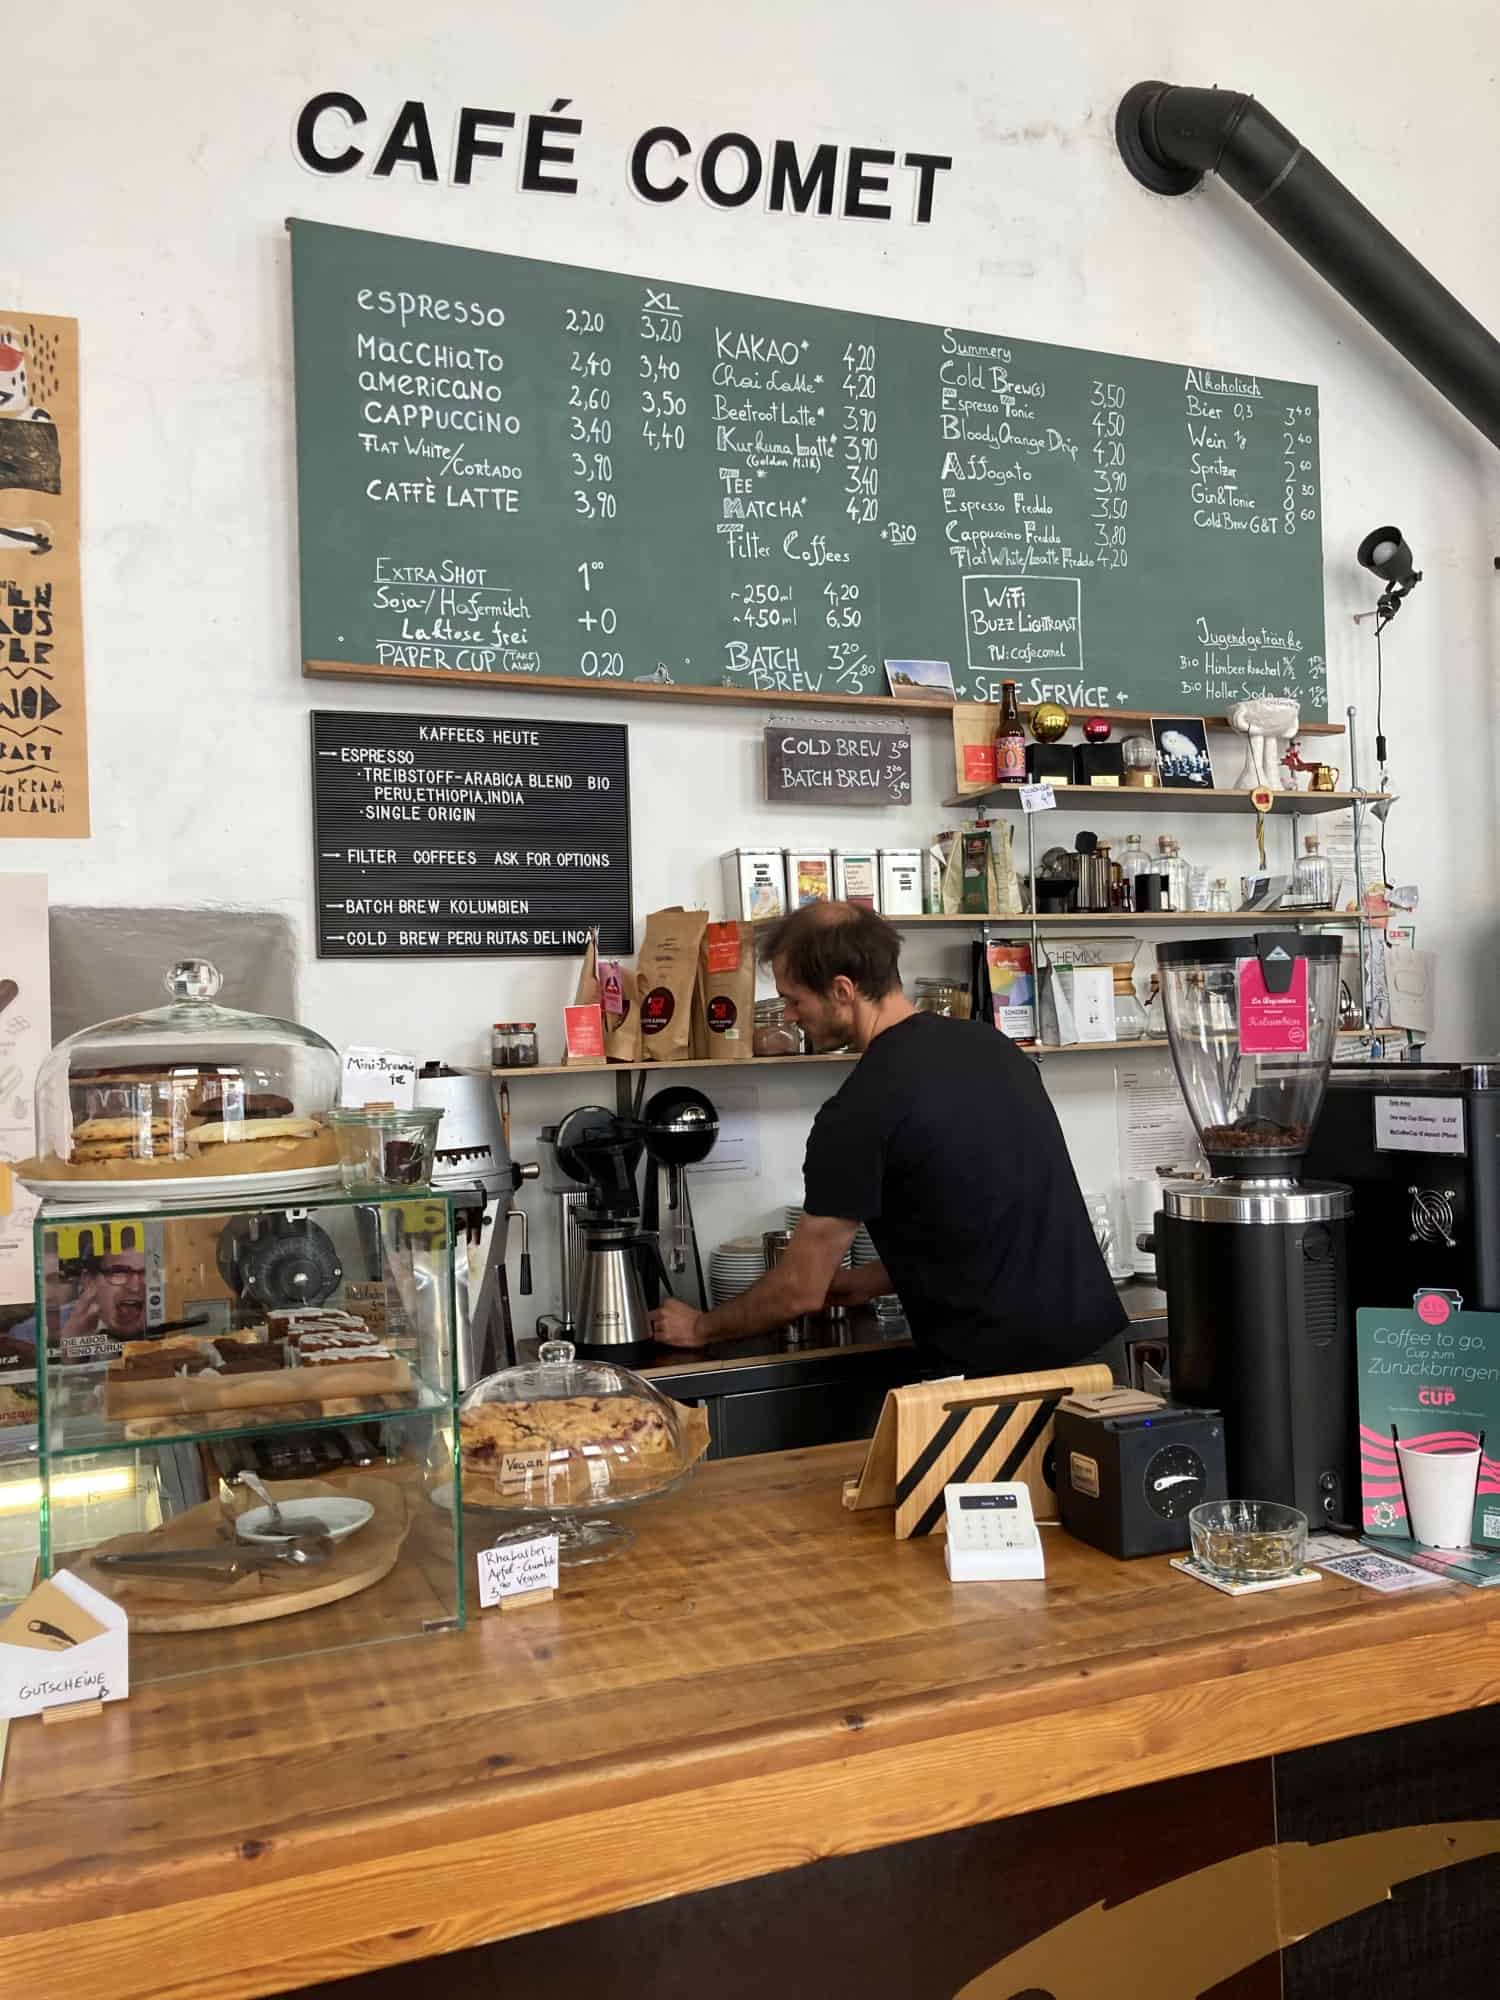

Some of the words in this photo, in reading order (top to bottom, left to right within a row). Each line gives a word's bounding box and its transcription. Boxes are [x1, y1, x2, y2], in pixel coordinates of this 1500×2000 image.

[297, 90, 584, 195] CAFÉ
[630, 125, 954, 225] COMET
[641, 288, 684, 317] XL
[566, 310, 604, 335] 2,20
[640, 316, 681, 343] 3,20
[570, 352, 612, 377] 2,40
[639, 355, 680, 383] 3,40
[842, 342, 876, 373] 4,20
[842, 373, 877, 400] 4,20
[939, 360, 985, 389] Cold
[1089, 380, 1125, 409] 3,50
[568, 385, 611, 411] 2,60
[640, 391, 686, 417] 3,50
[1186, 394, 1223, 419] Bier
[842, 405, 877, 433] 3,90
[1091, 411, 1125, 438] 4,50
[570, 416, 612, 444] 3,40
[642, 421, 685, 450] 4,40
[1187, 423, 1227, 450] Wein
[843, 435, 879, 462] 3,90
[1091, 440, 1126, 467] 4,20
[572, 453, 613, 482] 3,90
[844, 464, 879, 496] 3,40
[1092, 469, 1127, 494] 3,90
[446, 485, 520, 513] LATTE
[574, 490, 617, 519] 3,90
[845, 496, 879, 524] 4,20
[823, 581, 859, 607] 4,20
[825, 607, 862, 629] 6,50
[376, 643, 452, 671] PAPER
[456, 649, 497, 673] CUP
[748, 667, 823, 692] BREW
[419, 726, 485, 743] KAFFEES
[493, 730, 540, 746] HEUTE
[781, 737, 832, 756] COLD
[835, 738, 881, 757] BREW
[341, 748, 415, 764] ESPRESSO
[528, 774, 573, 789] BLEND
[587, 776, 611, 791] BIO
[781, 767, 833, 789] BATCH
[837, 769, 881, 788] BREW
[366, 806, 421, 821] SINGLE
[428, 808, 476, 822] ORIGIN
[347, 849, 397, 864] FILTER
[413, 851, 478, 865] COFFEES
[494, 852, 519, 866] ASK
[527, 852, 551, 866] FOR
[557, 853, 610, 867] OPTIONS
[345, 899, 393, 914] BATCH
[398, 900, 440, 914] BREW
[450, 900, 529, 914] KOLUMBIEN
[346, 931, 387, 946] COLD
[399, 931, 440, 946] BREW
[447, 931, 482, 946] PERU
[486, 931, 528, 945] RUTAS
[1437, 1332, 1454, 1347] to
[1418, 1391, 1457, 1407] CUP
